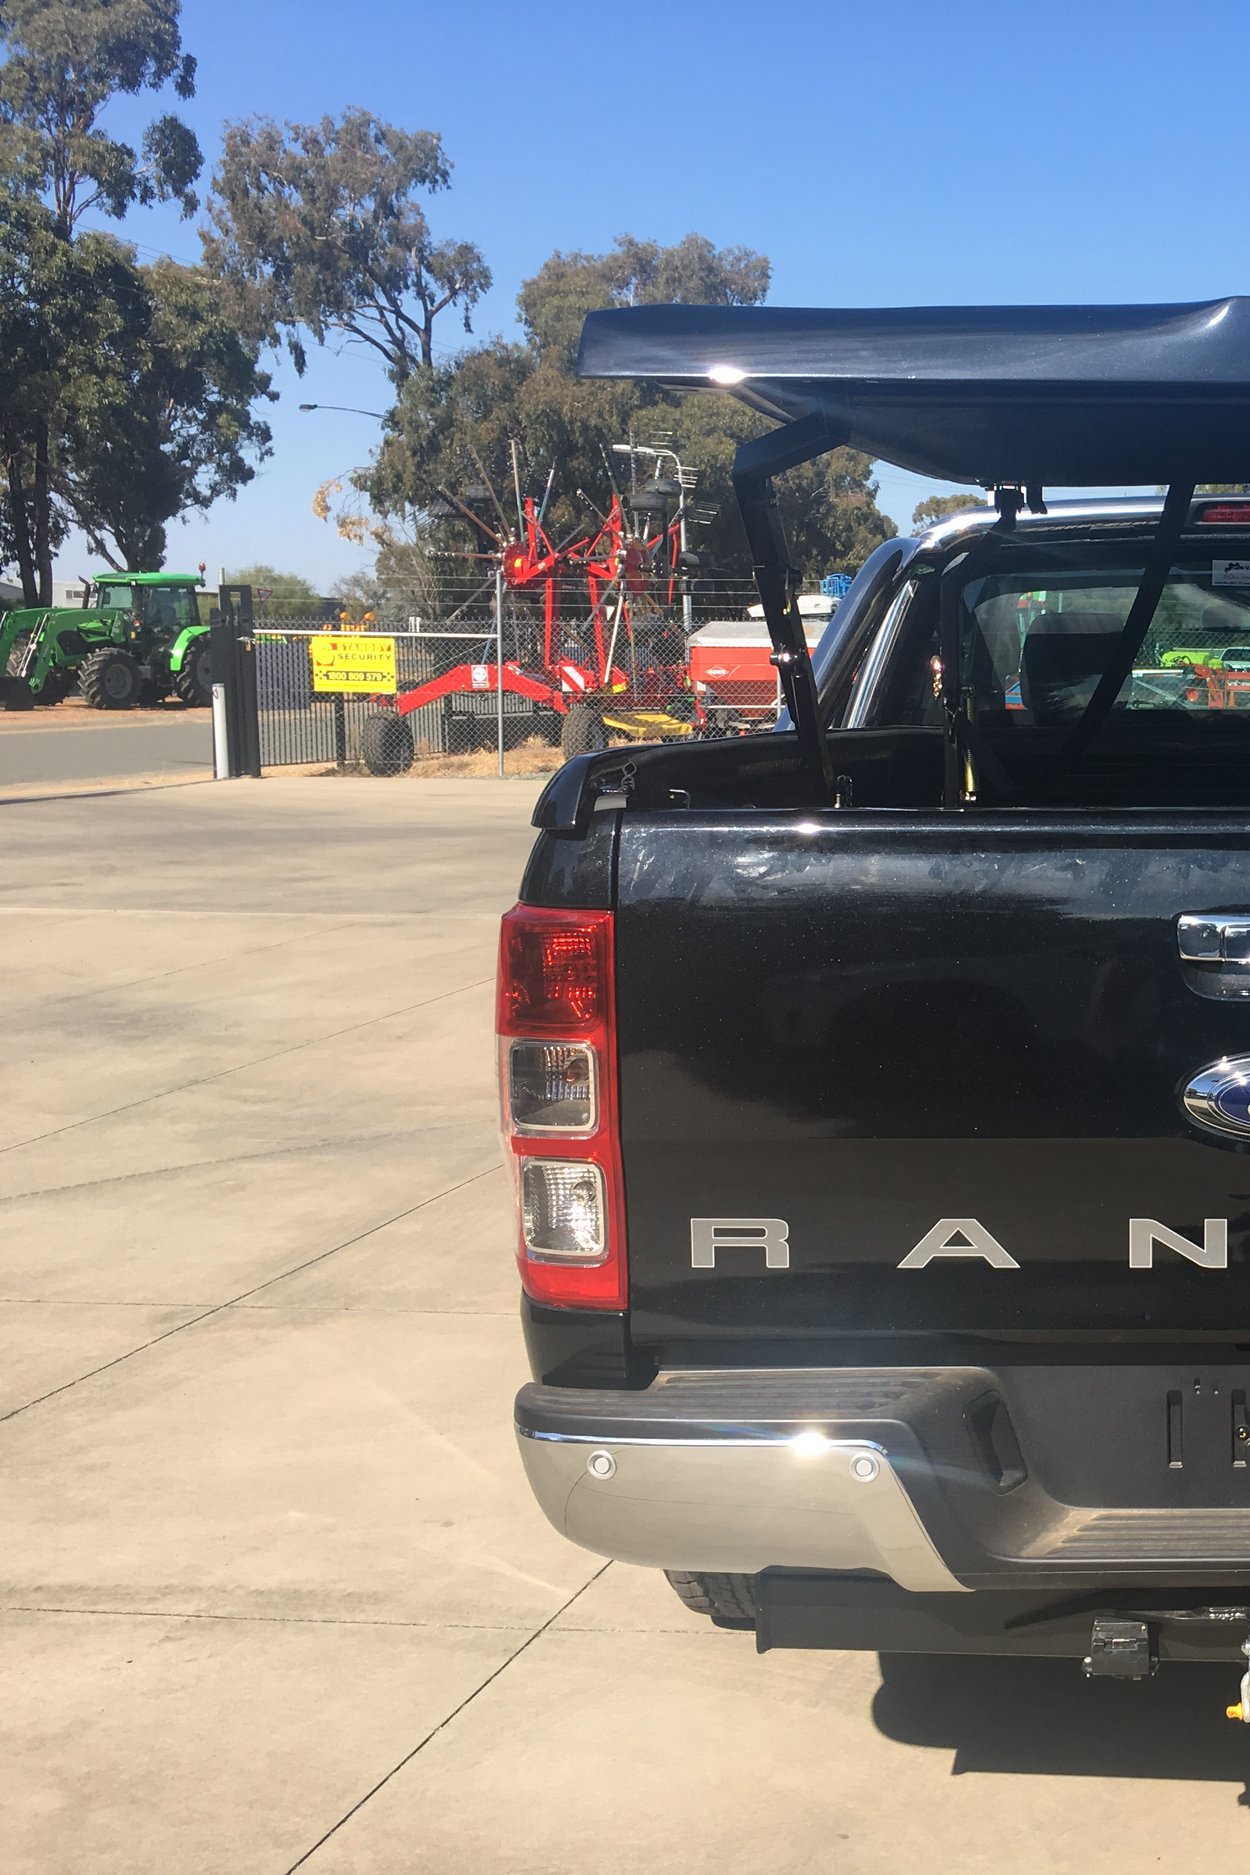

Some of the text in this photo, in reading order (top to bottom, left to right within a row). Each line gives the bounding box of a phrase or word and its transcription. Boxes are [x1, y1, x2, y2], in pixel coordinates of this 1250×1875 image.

[338, 653, 391, 661] SECURITY
[327, 672, 383, 681] 1800 809 579
